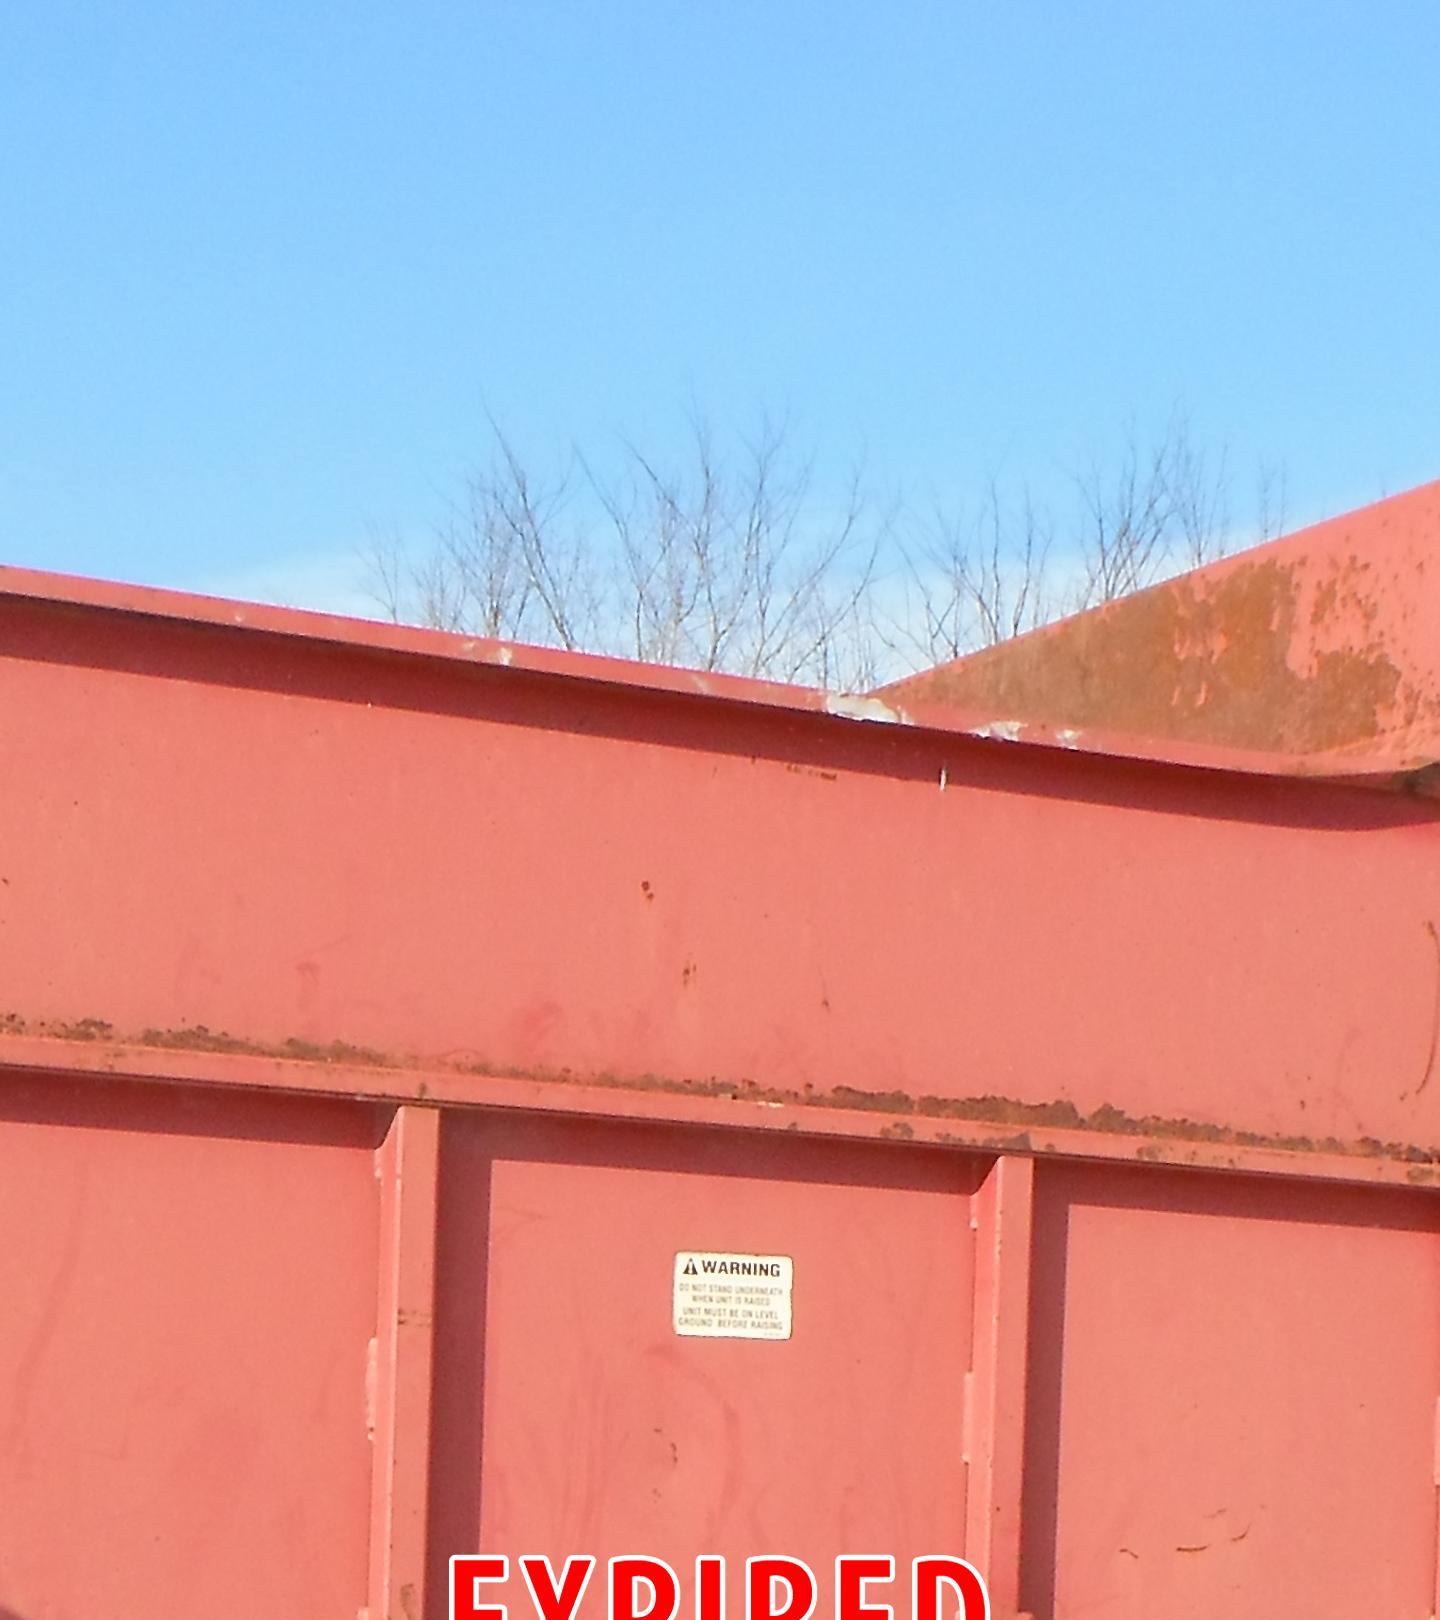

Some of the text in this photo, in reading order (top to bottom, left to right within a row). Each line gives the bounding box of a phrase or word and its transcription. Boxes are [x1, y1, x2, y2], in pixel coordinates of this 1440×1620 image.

[701, 1259, 781, 1277] WARNING
[679, 1283, 783, 1296] DO NOT STAND UNDERNEATH
[716, 1296, 732, 1304] UNIT
[744, 1297, 771, 1306] RAISED
[682, 1307, 778, 1320] UNIT MUST BE ON LEVEL
[678, 1317, 783, 1330] GROUND BEFORE RAISING
